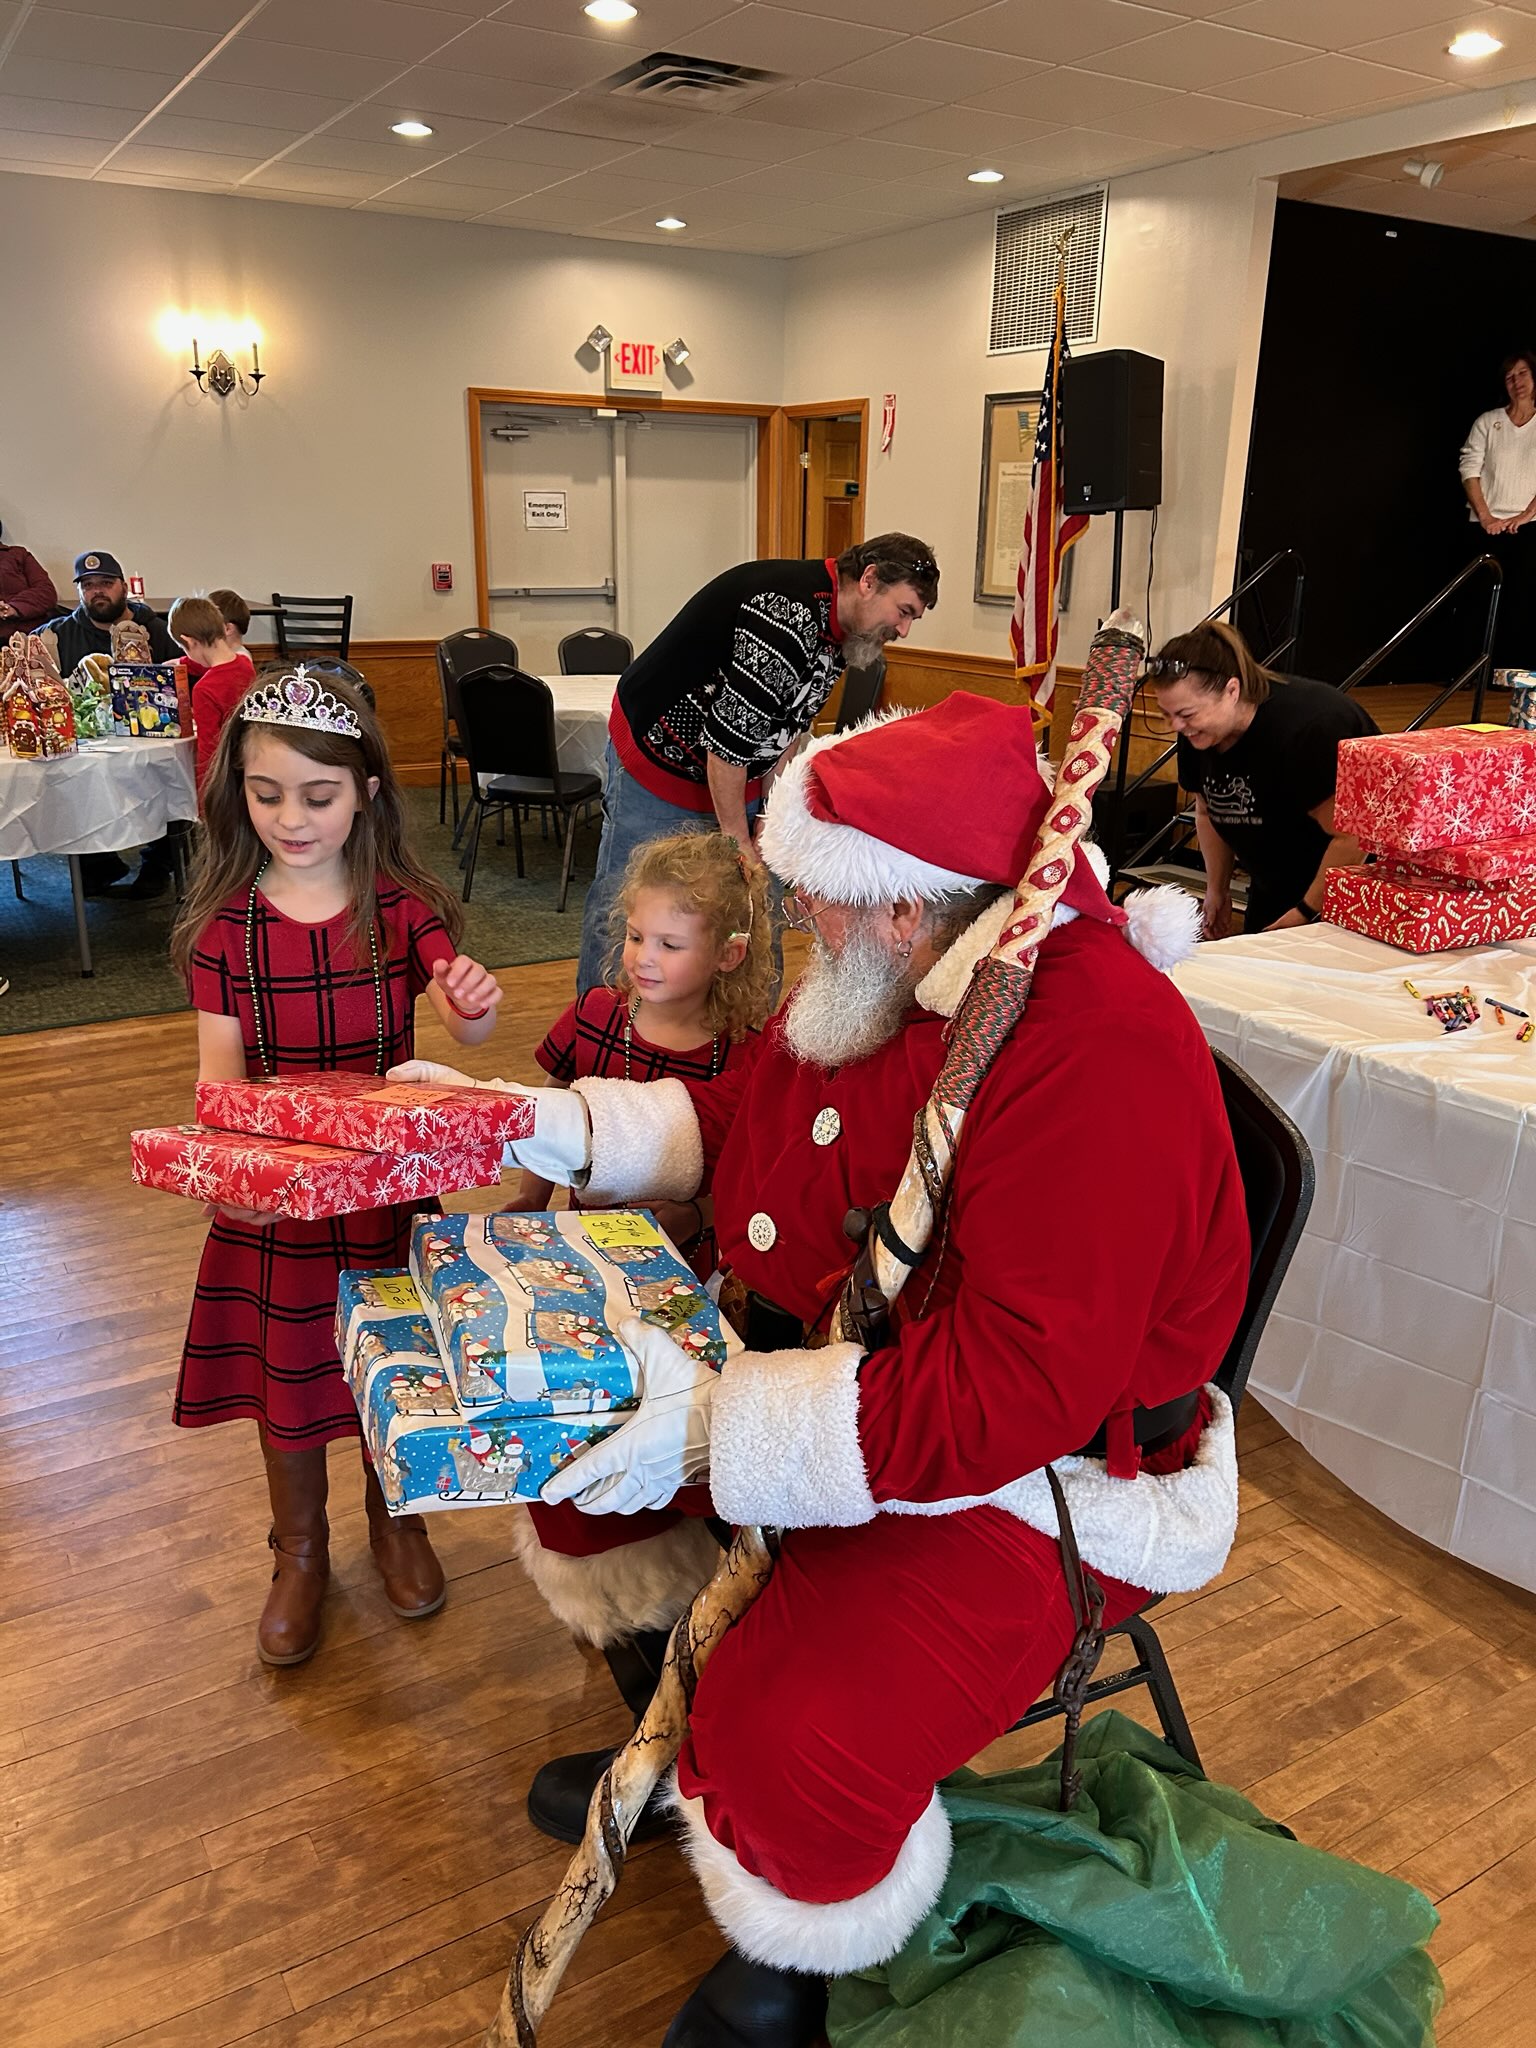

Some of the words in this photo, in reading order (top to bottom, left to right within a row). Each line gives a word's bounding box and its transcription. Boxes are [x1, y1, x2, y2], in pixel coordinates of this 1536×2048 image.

[621, 343, 655, 375] EXIT
[616, 1218, 639, 1227] 5
[383, 1283, 401, 1293] 5
